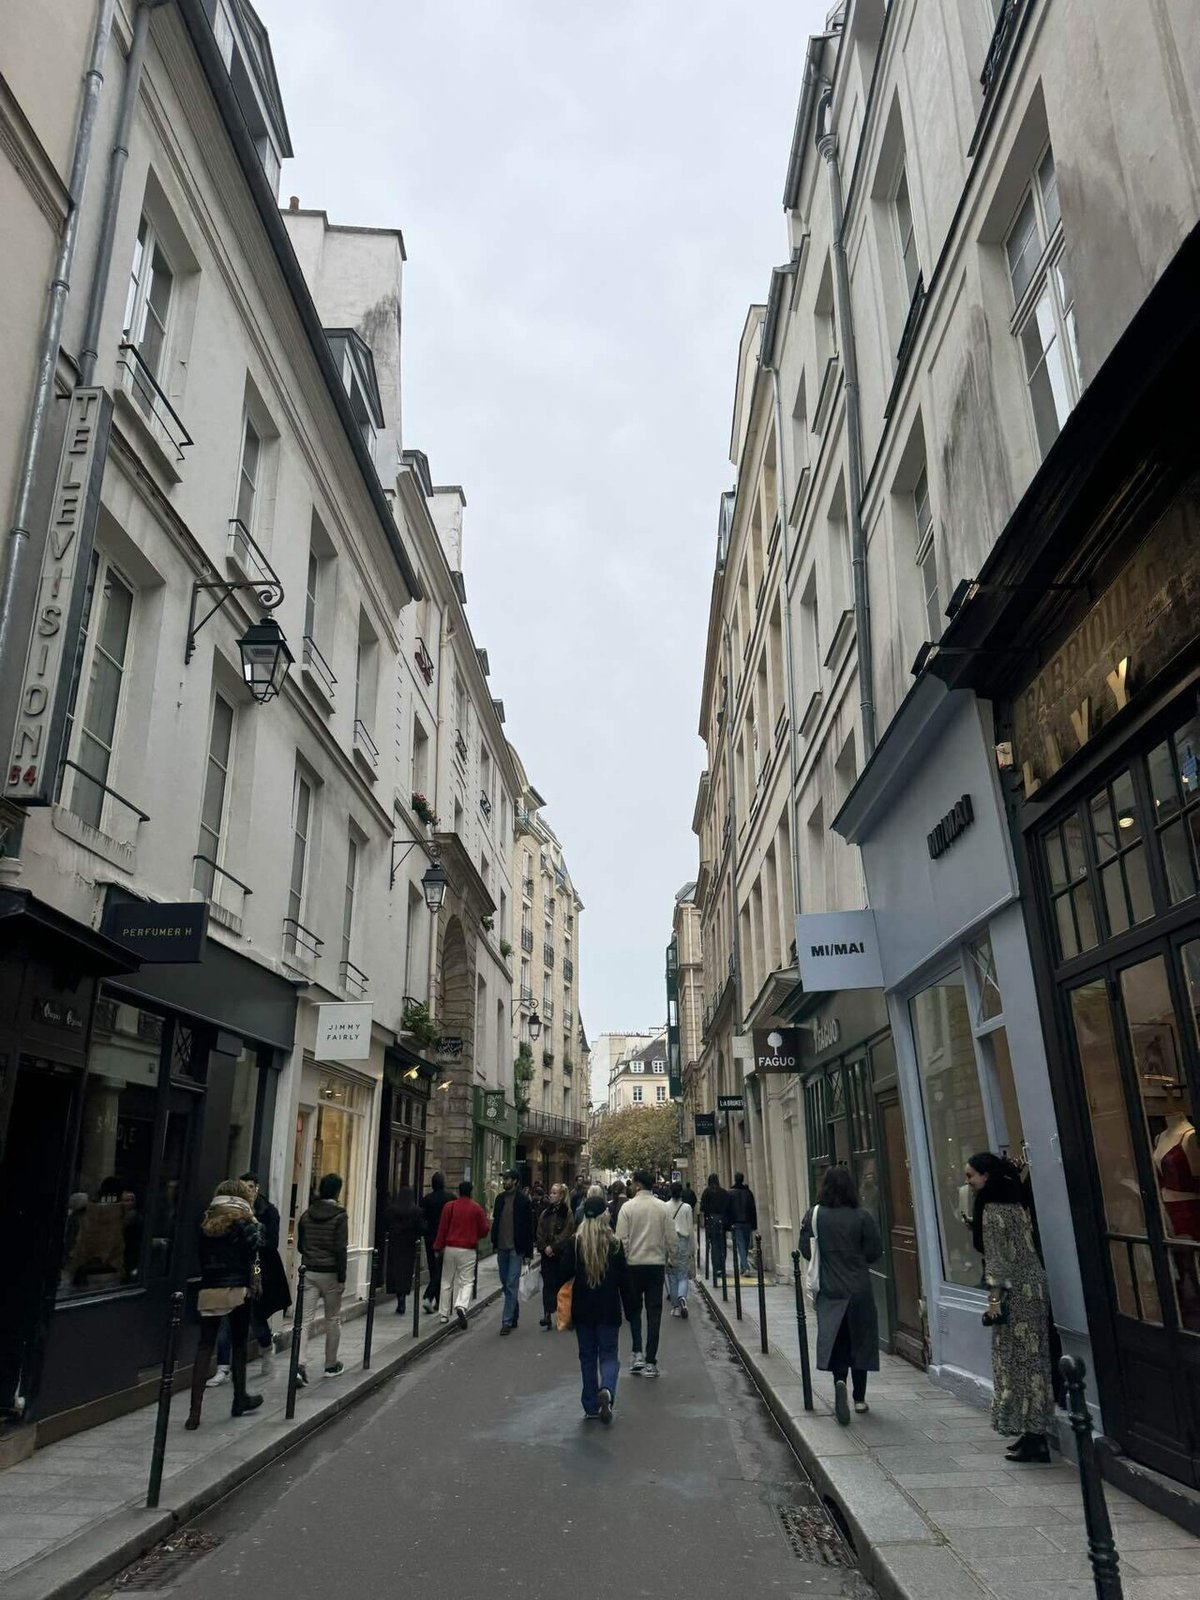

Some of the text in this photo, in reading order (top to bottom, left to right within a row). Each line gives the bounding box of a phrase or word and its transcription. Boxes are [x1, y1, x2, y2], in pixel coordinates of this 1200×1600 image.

[15, 396, 98, 758] TELEVISION
[1022, 657, 1129, 798] LIVY
[122, 927, 193, 937] PERFUMER H
[811, 942, 865, 957] MI/MAI
[328, 1023, 361, 1031] JIMMY
[758, 1056, 796, 1067] FAGUO
